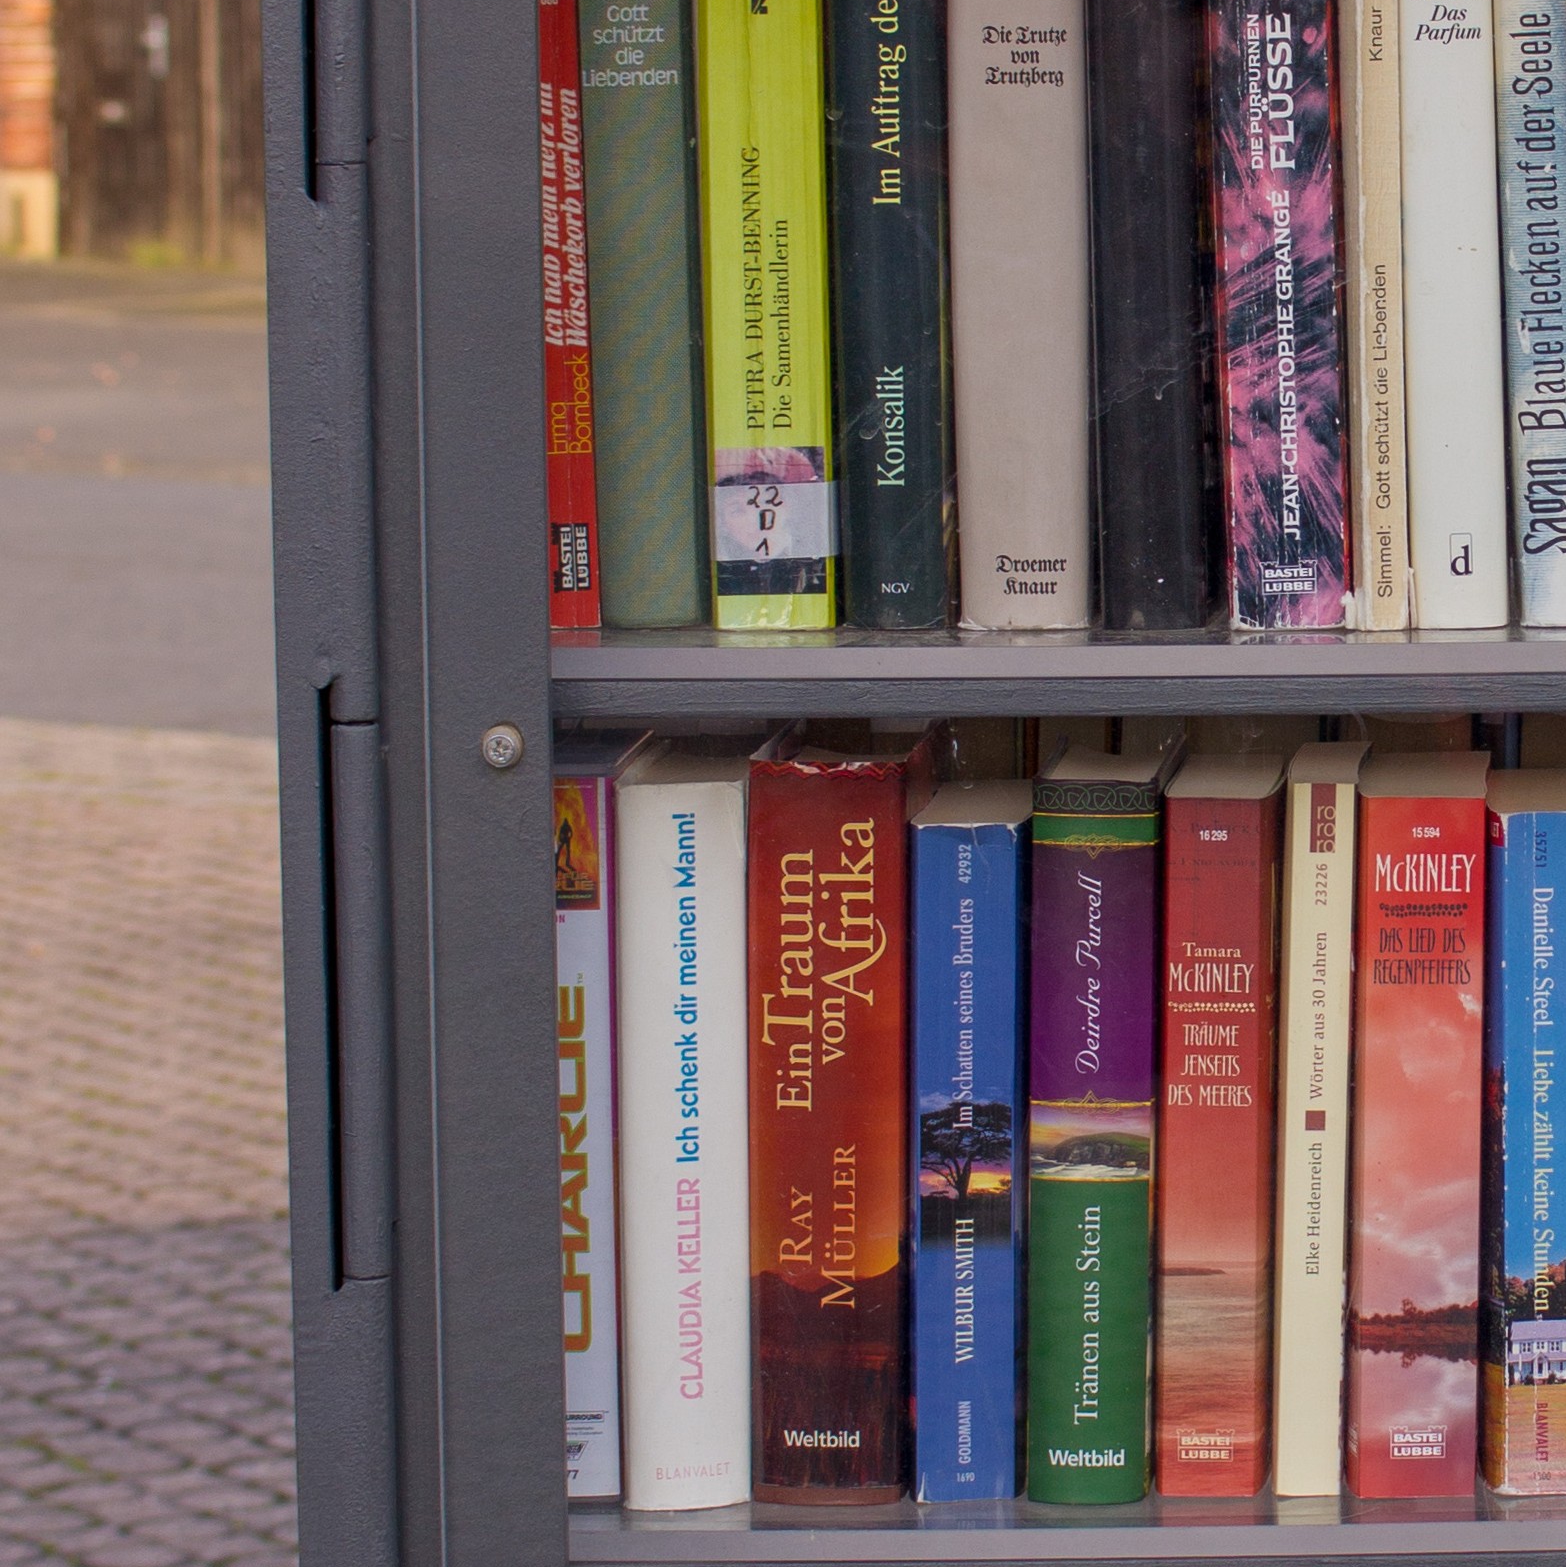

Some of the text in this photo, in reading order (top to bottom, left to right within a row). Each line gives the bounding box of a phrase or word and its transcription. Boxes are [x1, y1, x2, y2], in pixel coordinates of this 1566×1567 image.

[1430, 6, 1467, 22] Das
[1415, 23, 1481, 44] Parfum
[872, 43, 906, 157] Auftrag
[873, 168, 900, 205] Im
[878, 366, 904, 486] Konsalik
[996, 555, 1067, 573] Droemer
[881, 583, 910, 594] NGV
[1003, 577, 1058, 596] Knaur
[958, 843, 972, 884] 42932
[1182, 942, 1242, 958] Tamara
[1075, 871, 1102, 1074] Deirdre Purcell
[1182, 1021, 1239, 1047] TRÄUME
[1181, 1055, 1240, 1076] JENSEITS
[1168, 1085, 1253, 1107] DES MEERES
[779, 1186, 813, 1265] RAY
[820, 1144, 857, 1309] MÜLLER
[676, 1178, 703, 1400] CLAUDIA KELLER
[955, 1218, 974, 1364] WILBUR SMITH
[784, 1430, 860, 1448] Weltbild
[958, 1400, 972, 1464] GOLDMANN
[1049, 1449, 1125, 1467] Weltbild
[655, 1462, 731, 1481] BLANVALET
